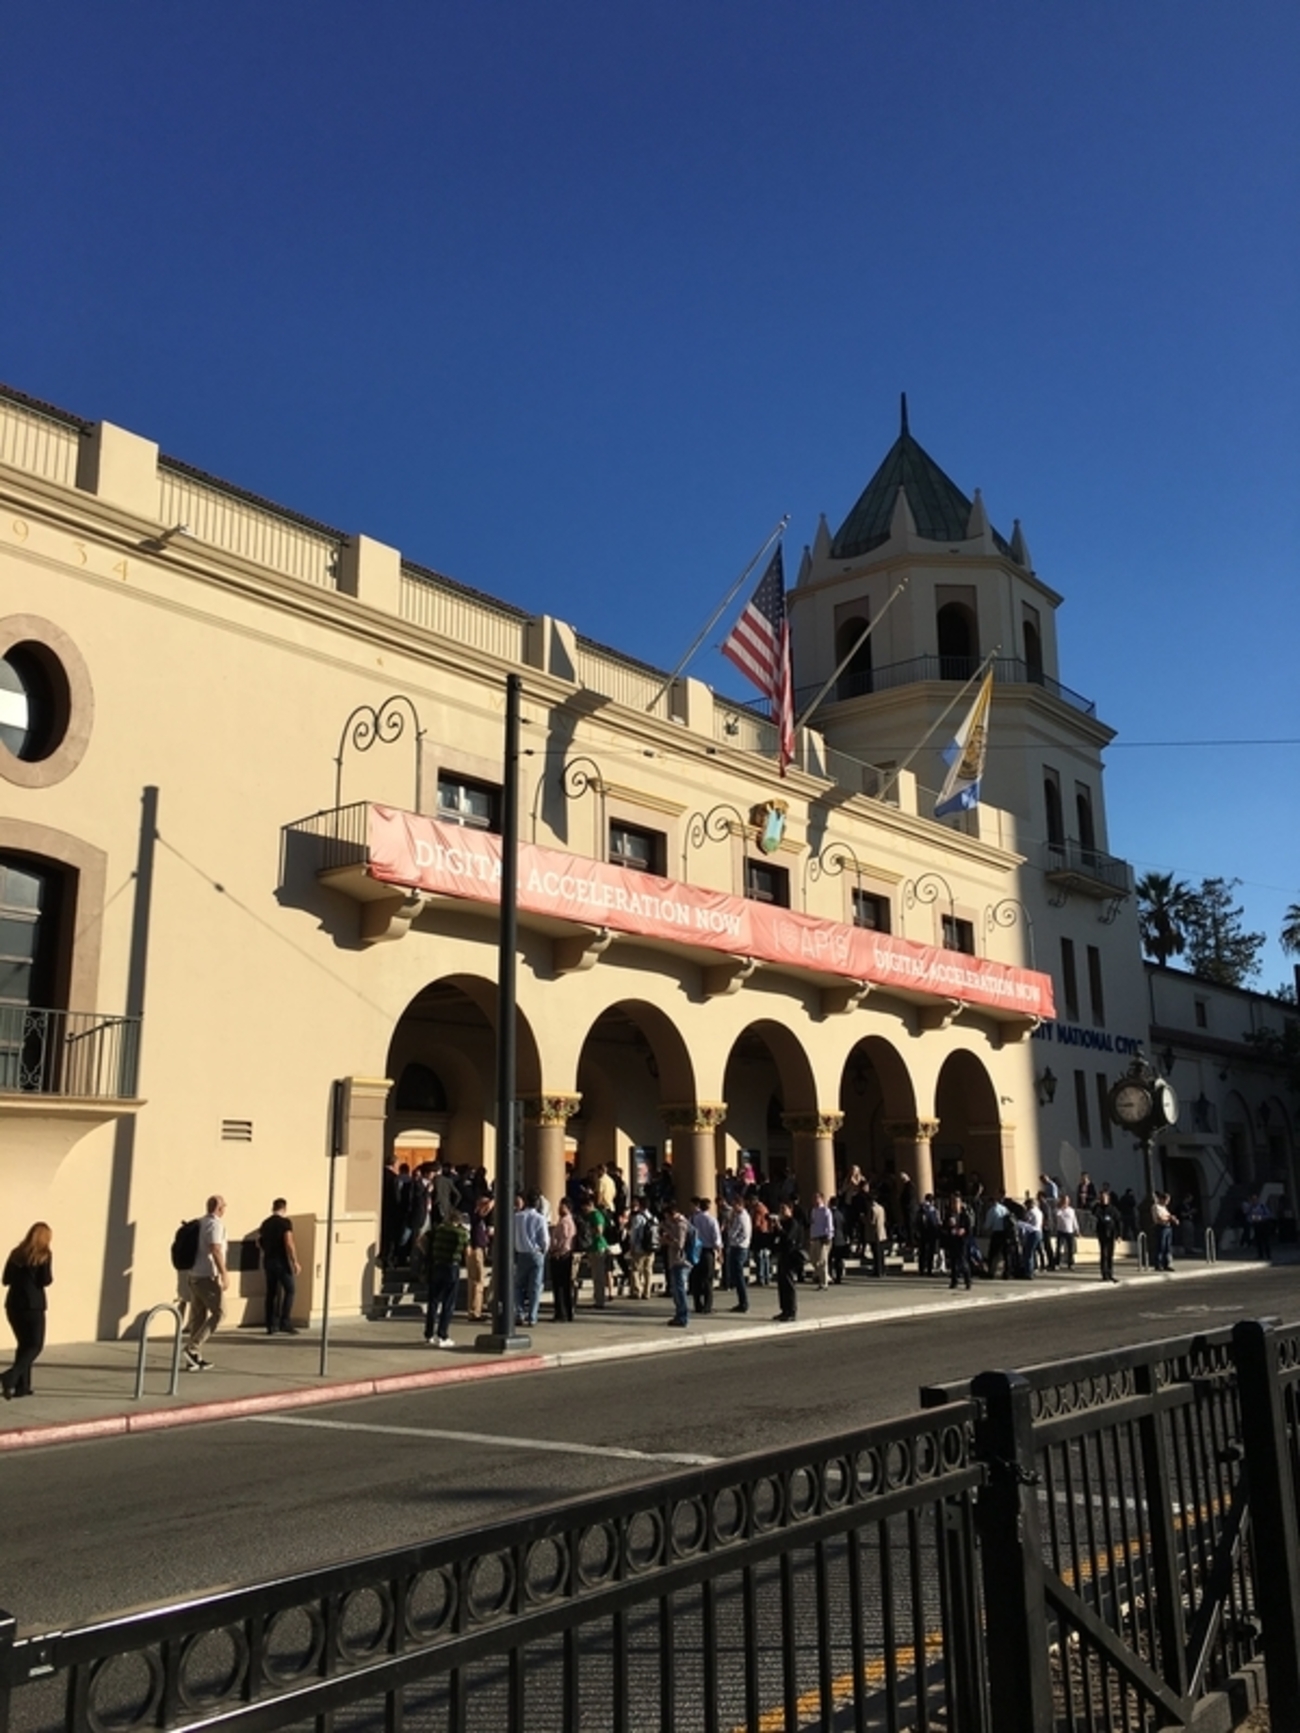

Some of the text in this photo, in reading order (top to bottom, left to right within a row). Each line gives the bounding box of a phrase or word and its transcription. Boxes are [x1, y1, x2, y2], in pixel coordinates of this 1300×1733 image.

[415, 839, 741, 937] DIGITA ACCELERATION NOW
[873, 949, 1041, 1002] DIGITAL ACCELERATION NOW
[1056, 1023, 1114, 1053] NATIONAL
